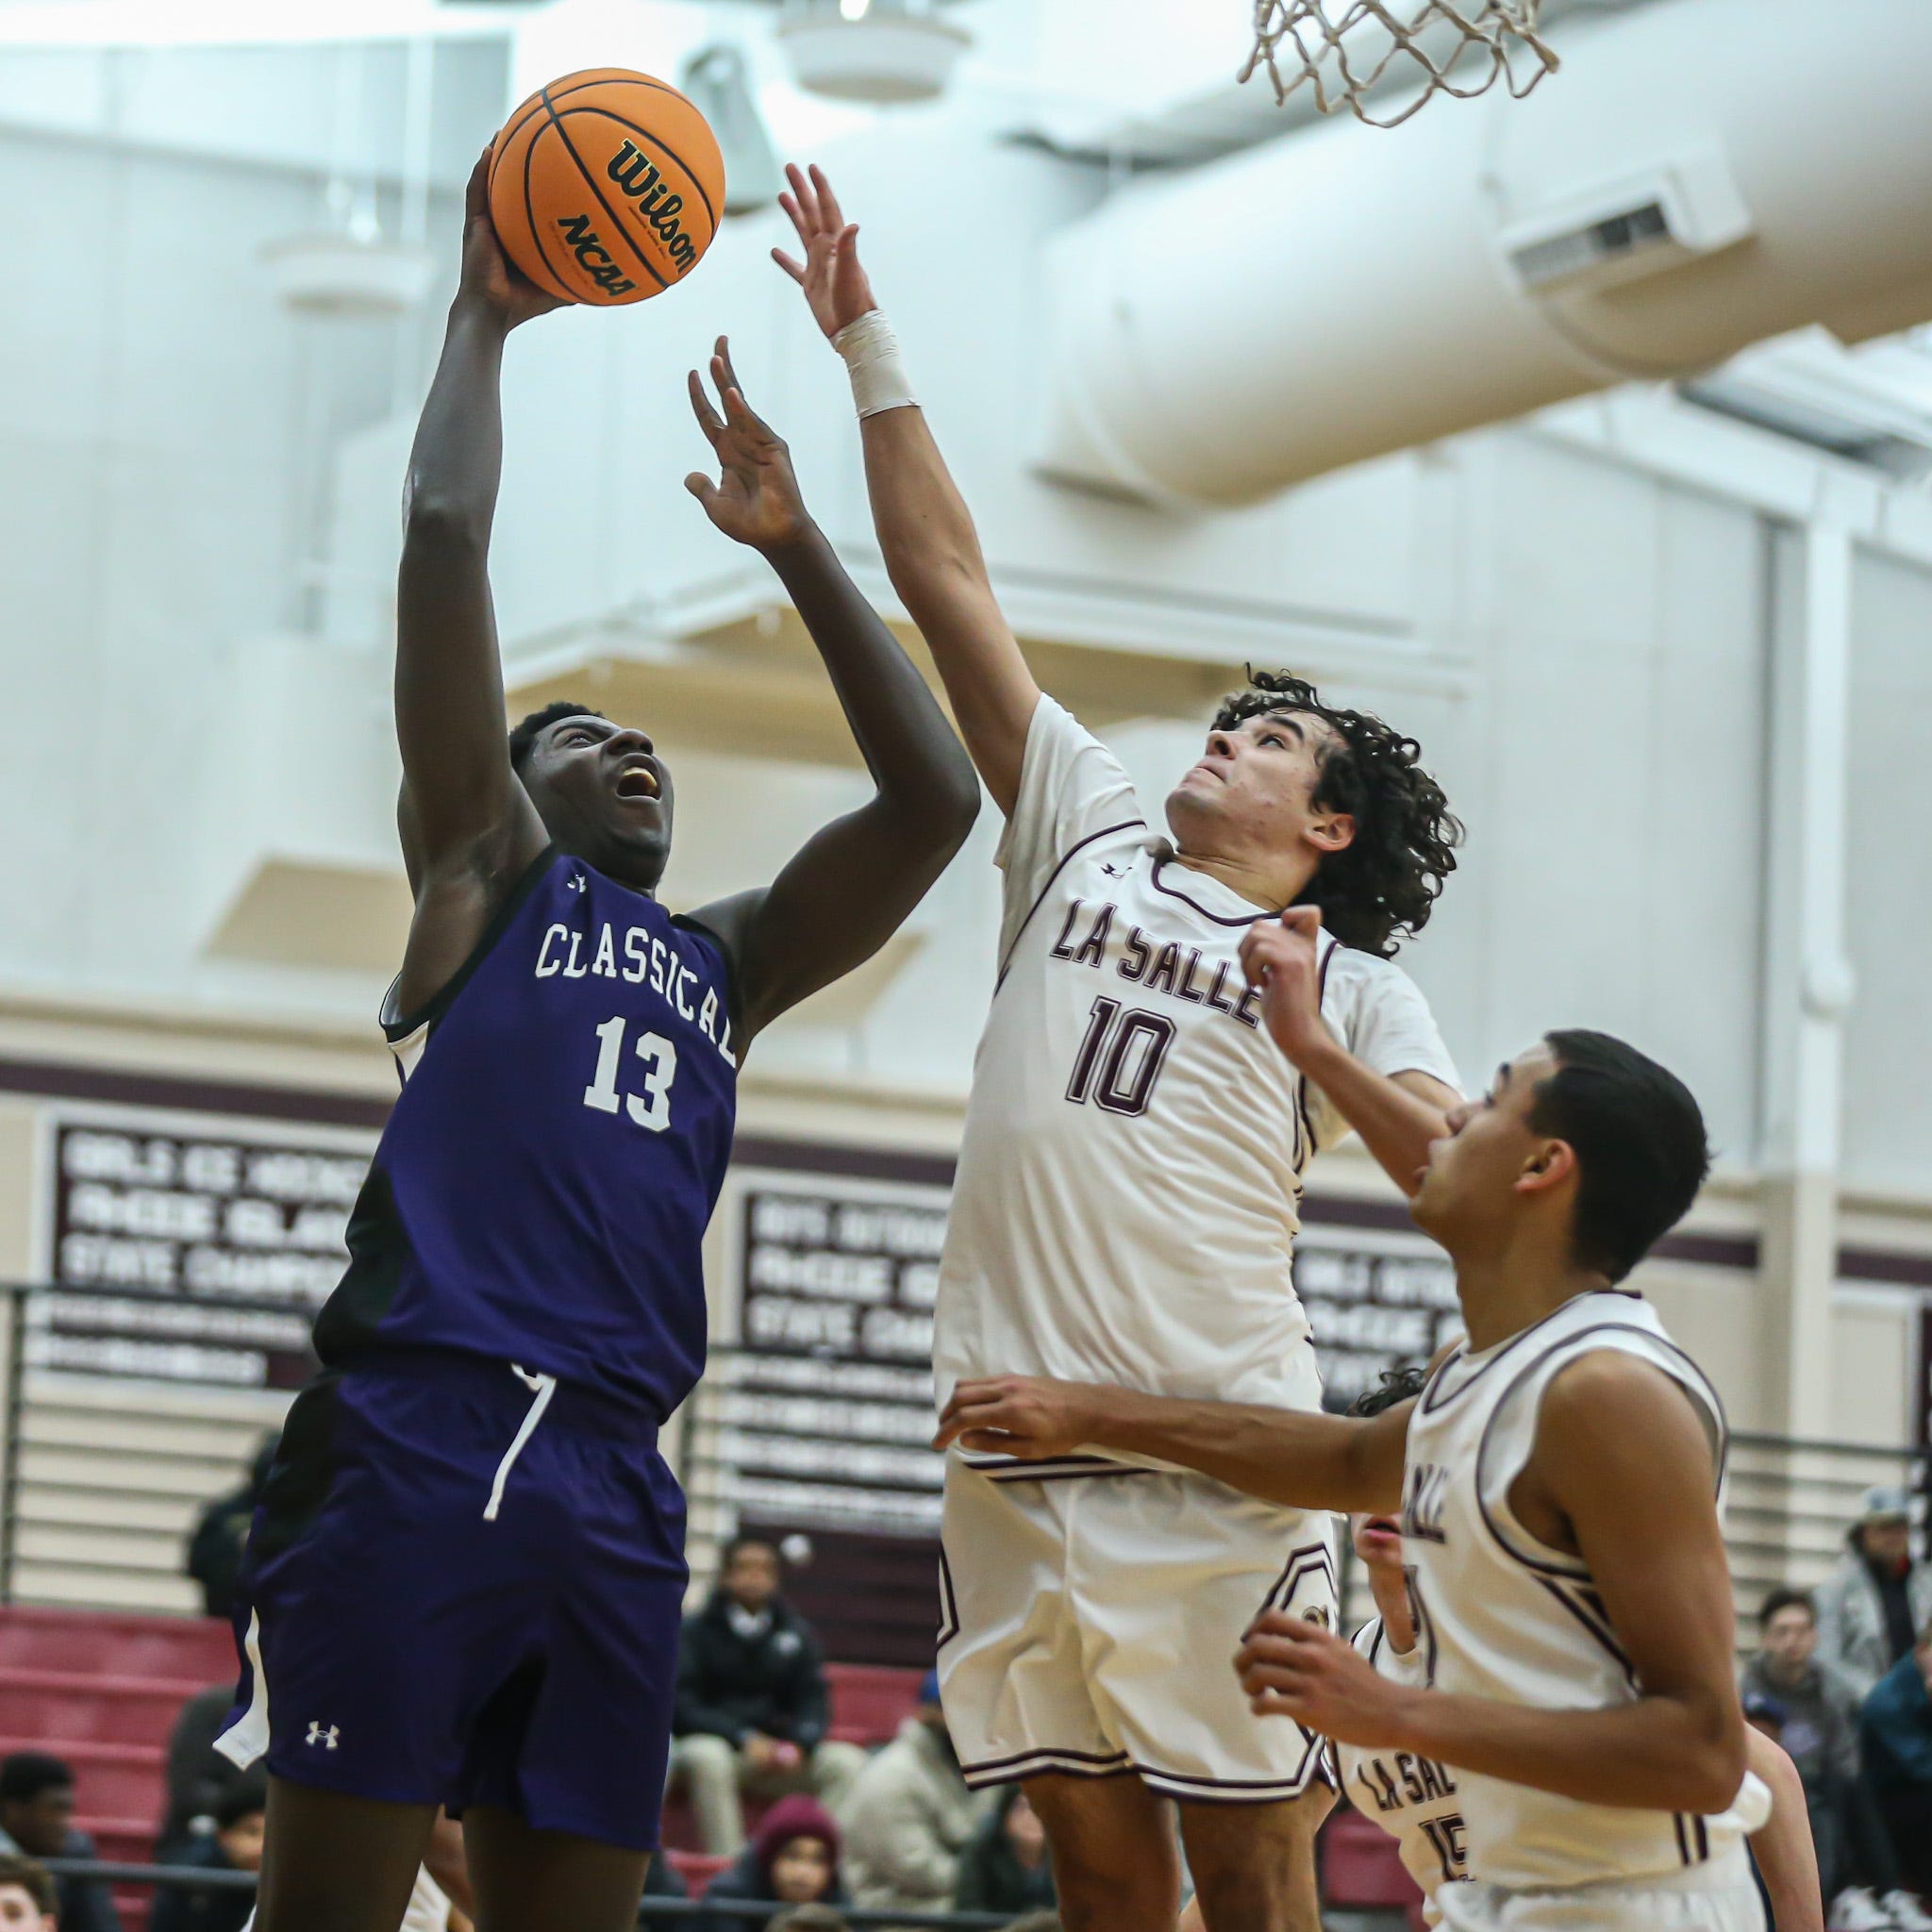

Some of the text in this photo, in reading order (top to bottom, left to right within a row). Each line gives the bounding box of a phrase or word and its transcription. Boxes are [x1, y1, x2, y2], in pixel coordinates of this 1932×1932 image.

[557, 214, 637, 296] NCAA
[607, 138, 698, 274] Wilson
[535, 922, 736, 1069] CLASSICAL
[1049, 897, 1261, 1029] LA SALLE
[583, 1015, 678, 1132] 13
[1064, 994, 1177, 1117] 10
[1357, 1758, 1405, 1811] LA
